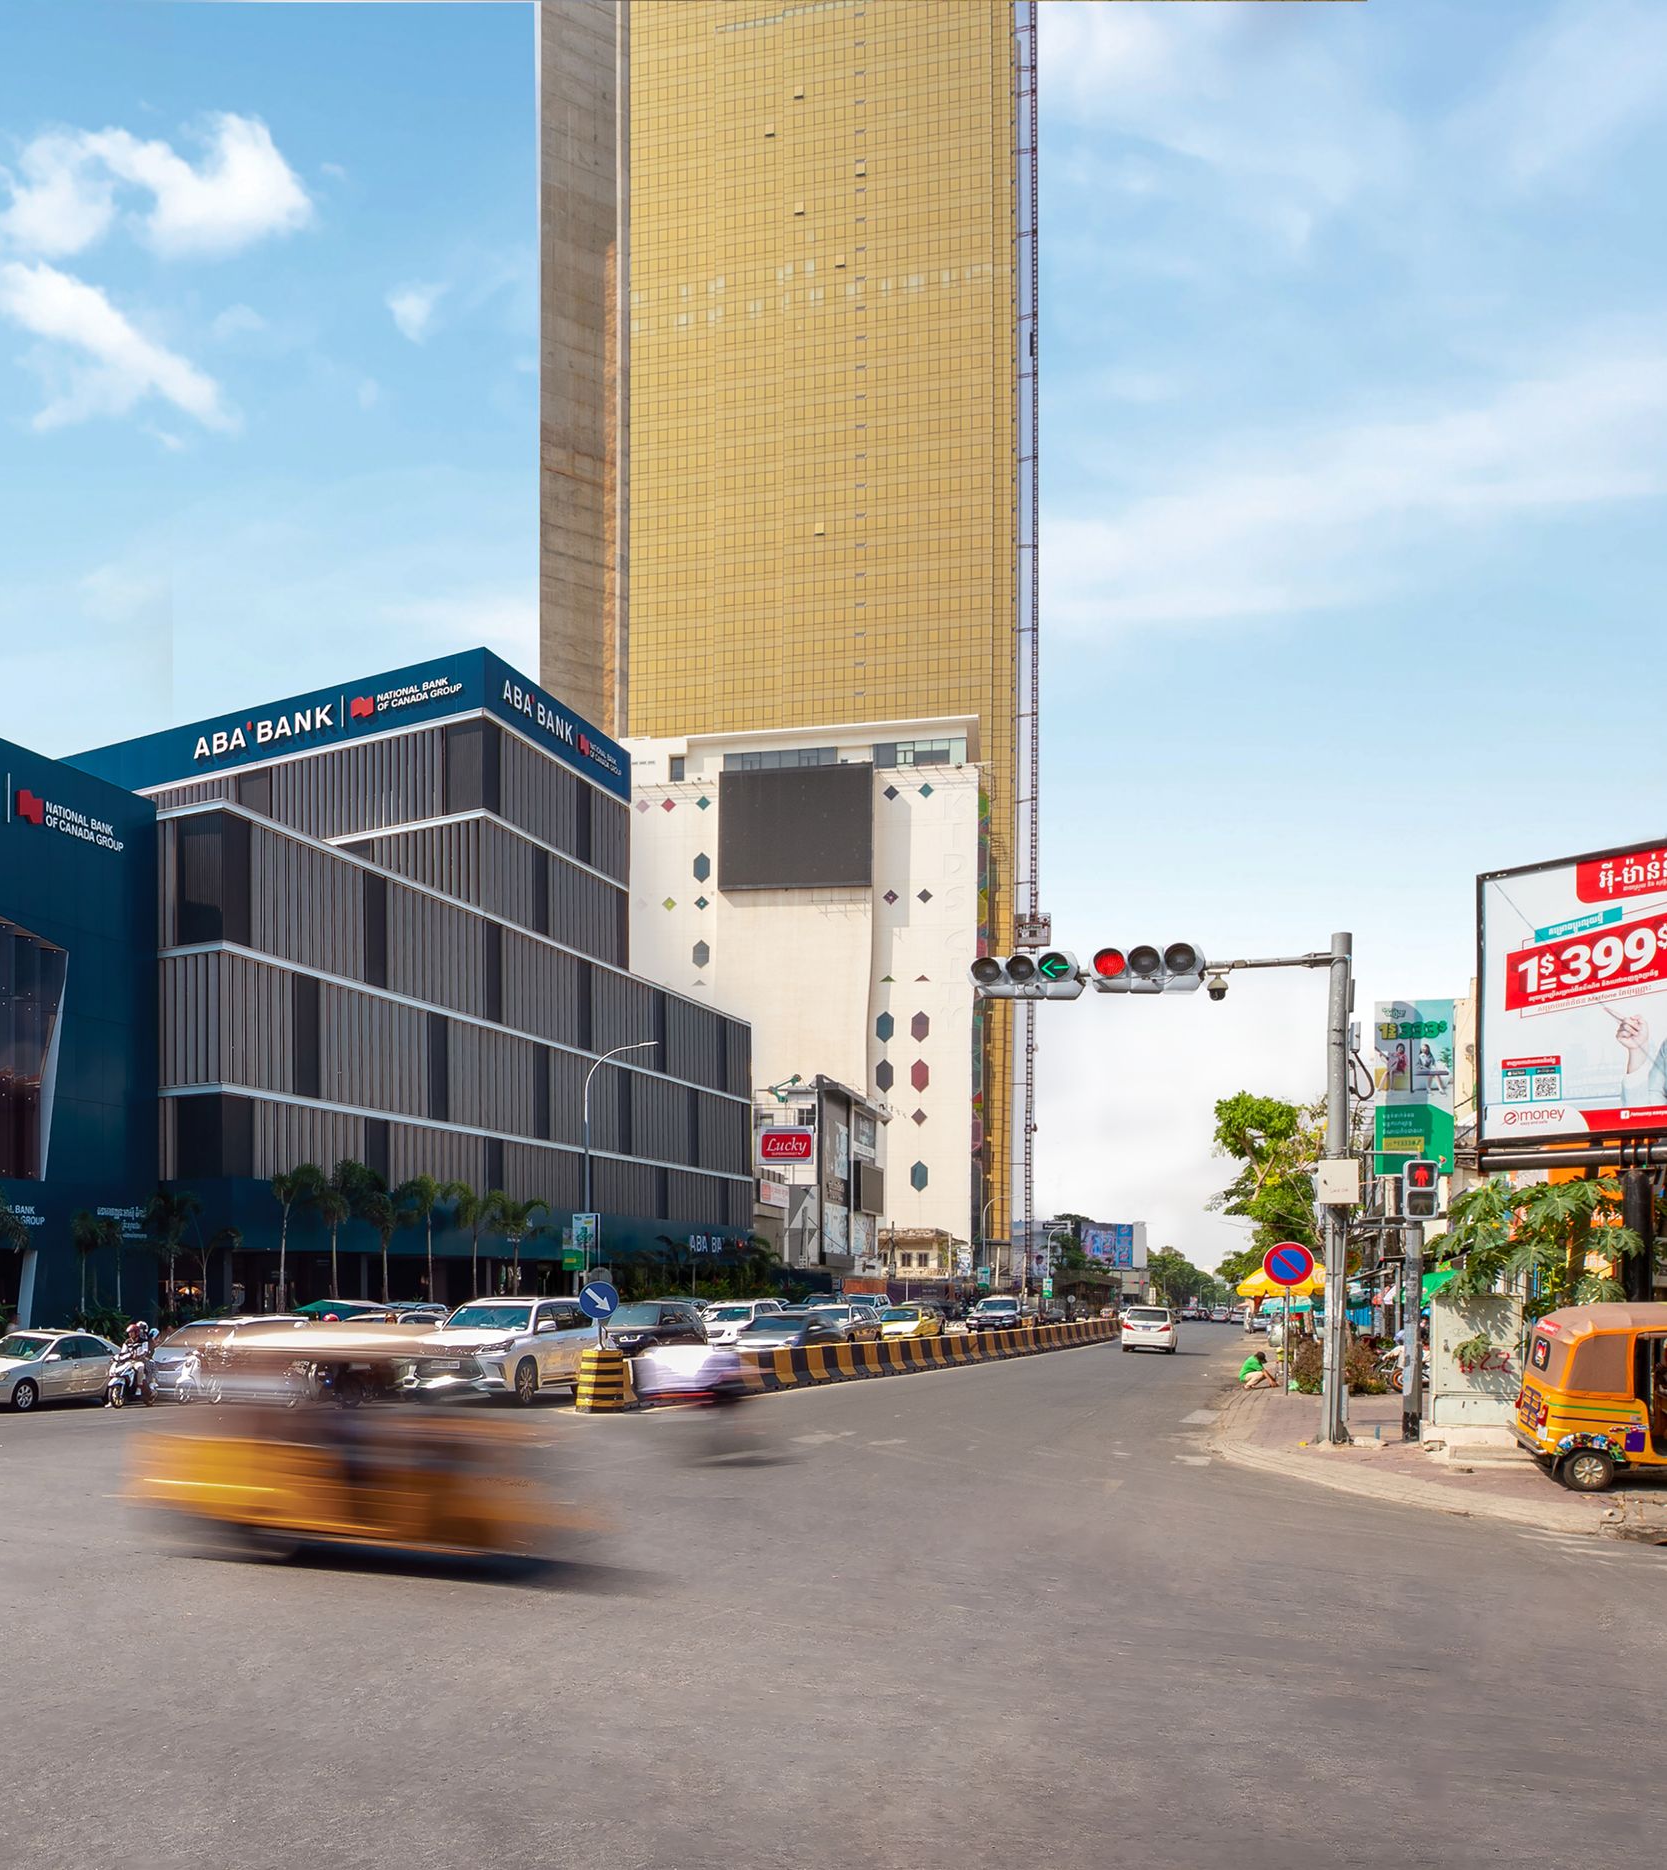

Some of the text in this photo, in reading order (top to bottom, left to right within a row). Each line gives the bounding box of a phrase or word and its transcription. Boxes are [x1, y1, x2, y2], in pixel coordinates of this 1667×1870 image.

[377, 677, 448, 702] NATIONAL BANK
[377, 683, 462, 711] OF CANADA GROUP
[256, 703, 334, 745] BANK
[537, 702, 573, 746] BANK
[45, 801, 114, 836] NATIONAL BANK
[45, 814, 124, 852] OF CANADA GROUP
[766, 1137, 807, 1155] Lucky
[15, 1204, 35, 1214] BANK
